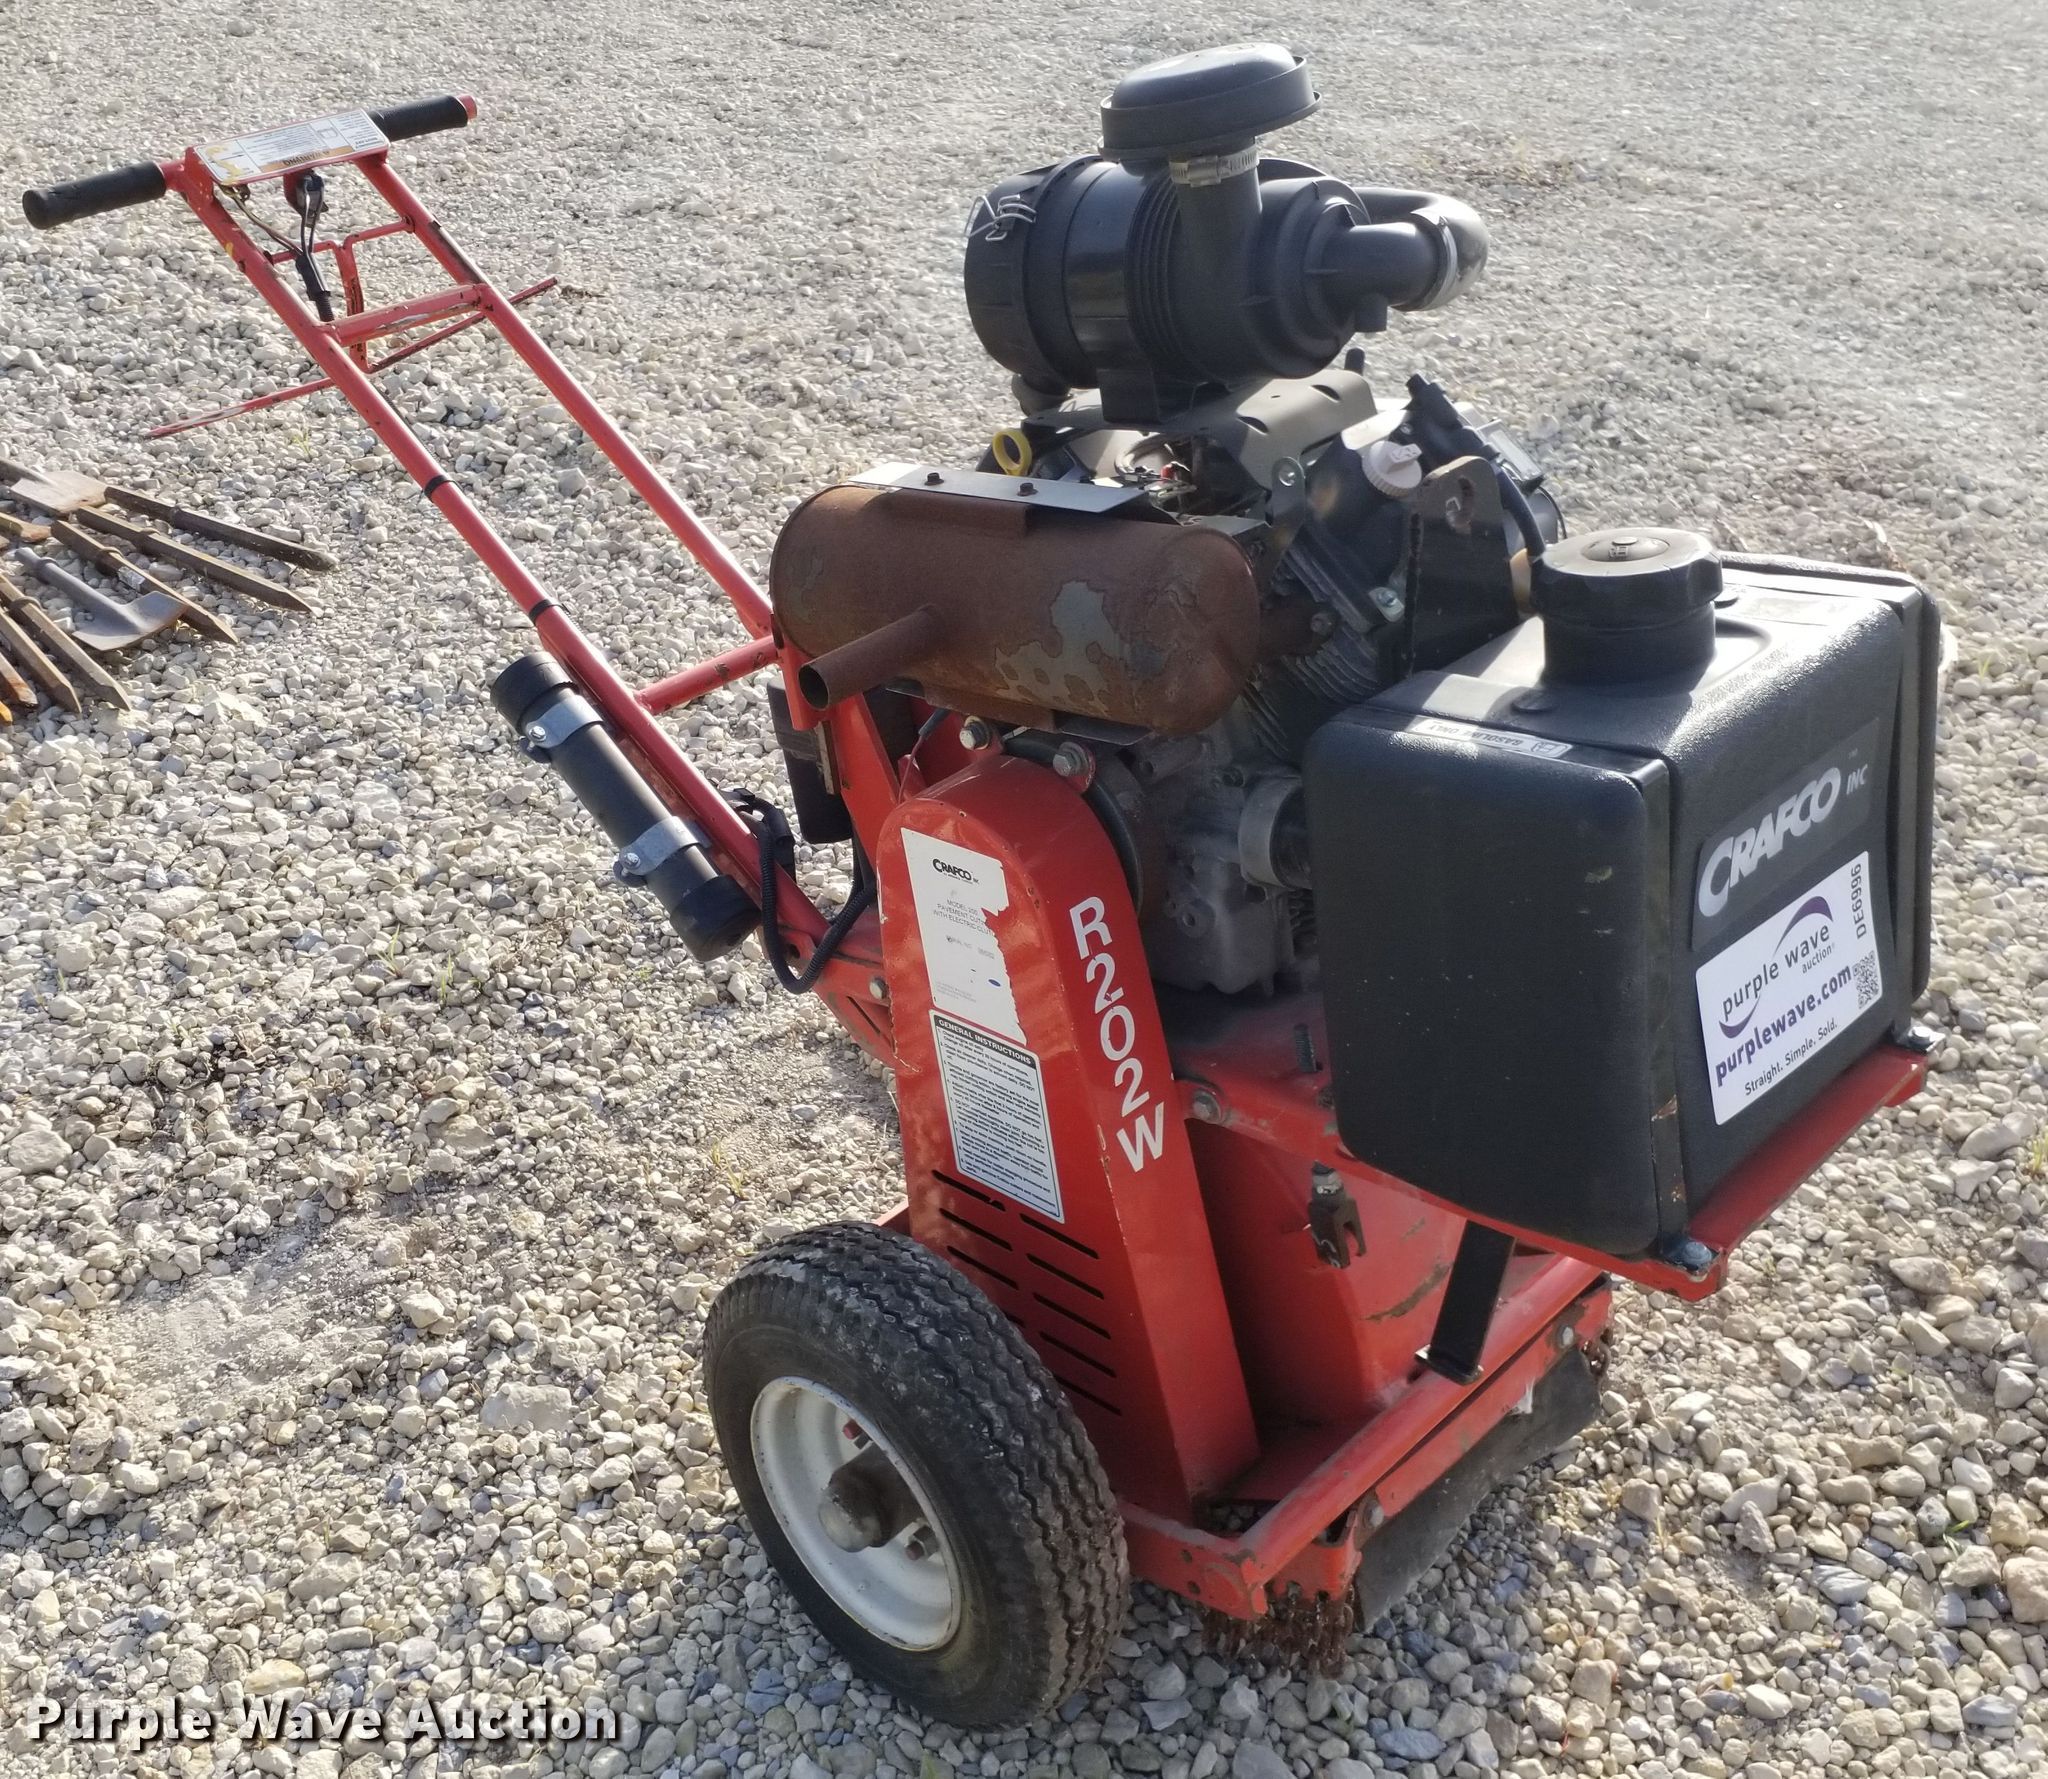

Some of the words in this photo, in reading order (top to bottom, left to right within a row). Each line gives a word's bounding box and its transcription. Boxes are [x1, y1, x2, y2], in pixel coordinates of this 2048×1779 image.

[932, 859, 971, 880] CRAFCO
[1698, 767, 1841, 917] CRAFCO
[1850, 863, 1867, 940] DE6996
[1722, 960, 1779, 1021] purple
[1785, 922, 1830, 968] wave
[1802, 946, 1833, 974] auction
[938, 1019, 974, 1040] GENERAL
[975, 1034, 1032, 1065] INSTRUCTIONS
[1069, 896, 1165, 1173] R202W
[1715, 964, 1851, 1087] purplewave.com
[1745, 1063, 1783, 1096] Straight.
[1785, 1038, 1816, 1066] Simple.
[1818, 1018, 1838, 1040] Sold.
